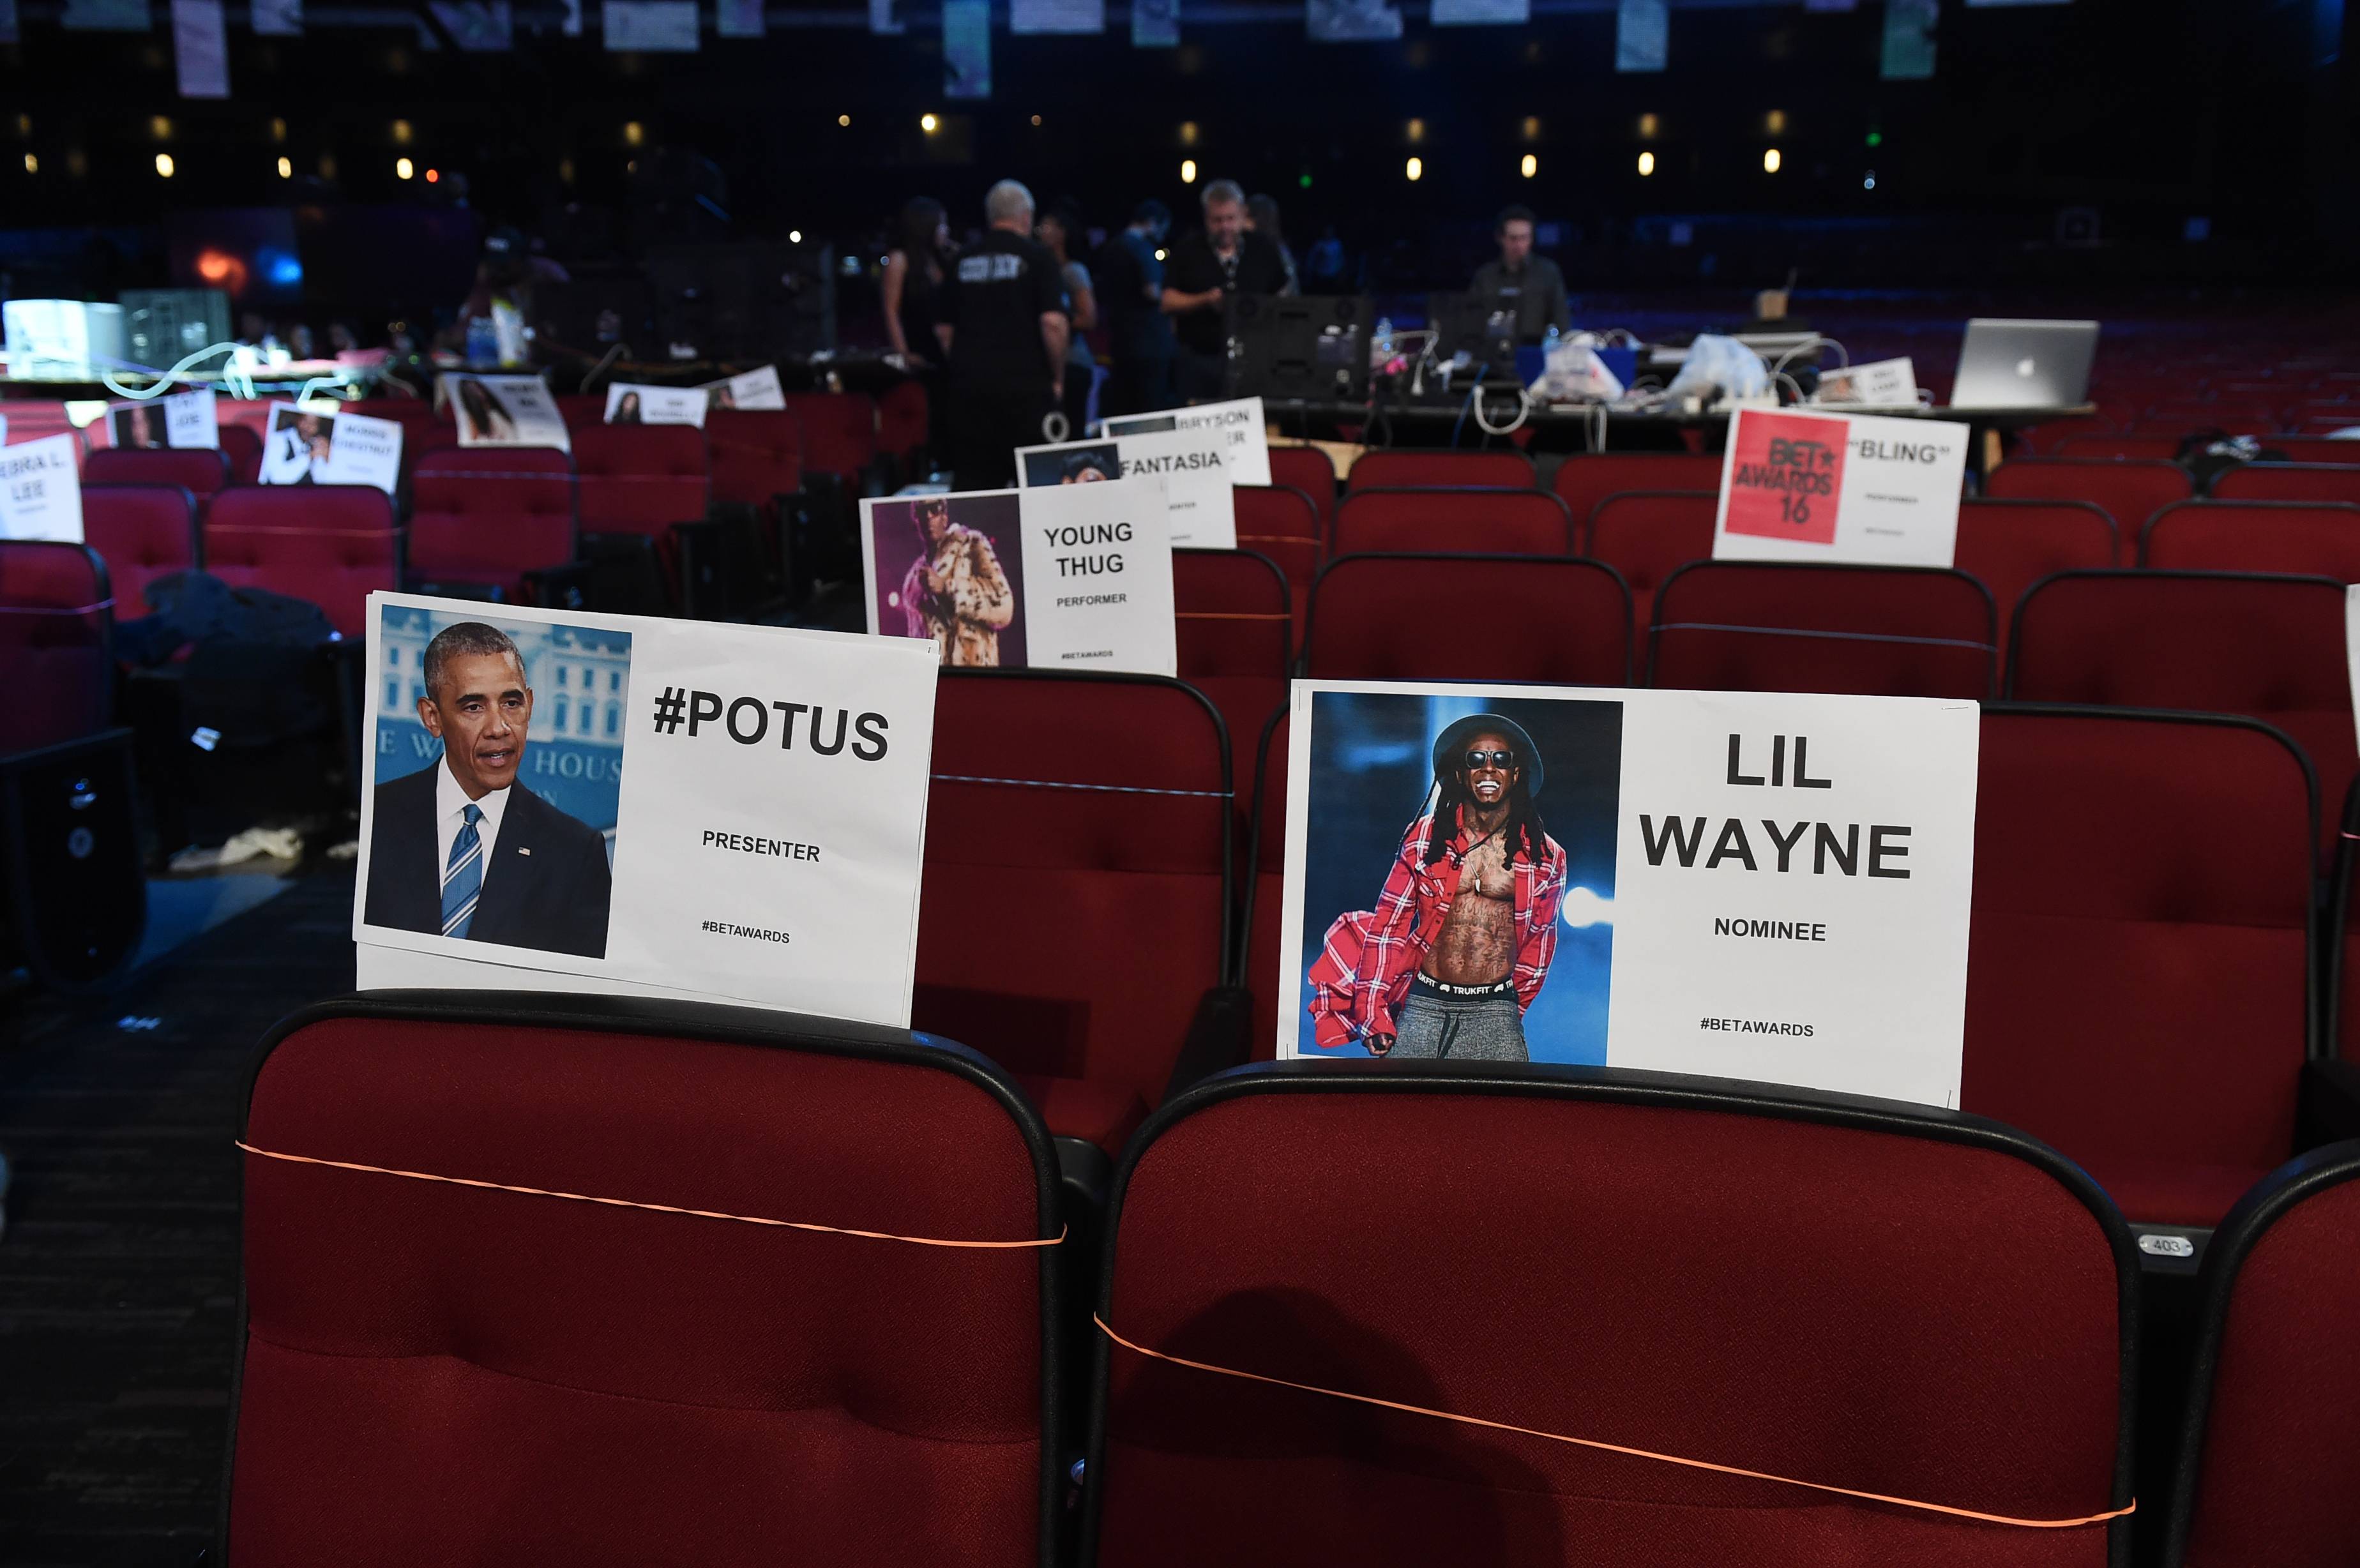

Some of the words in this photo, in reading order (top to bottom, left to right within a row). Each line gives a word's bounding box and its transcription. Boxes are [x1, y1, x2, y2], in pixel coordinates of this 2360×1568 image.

[1121, 451, 1222, 477] FANTASIA
[1736, 462, 1833, 496] AWARDS
[1781, 496, 1811, 524] 16
[1044, 522, 1133, 547] YOUNG
[1055, 553, 1124, 577] THUG
[1057, 593, 1127, 607] PERFORMER
[654, 687, 889, 762] #POTUS
[1727, 734, 1832, 789] LIL
[702, 830, 820, 863] PRESENTER
[1638, 814, 1912, 879] WAYNE
[702, 920, 790, 944] #BETAWARDS
[1714, 917, 1826, 942] NOMINEE
[1453, 986, 1489, 995] TRUKFIT
[1700, 1017, 1814, 1037] #BETAWARDS
